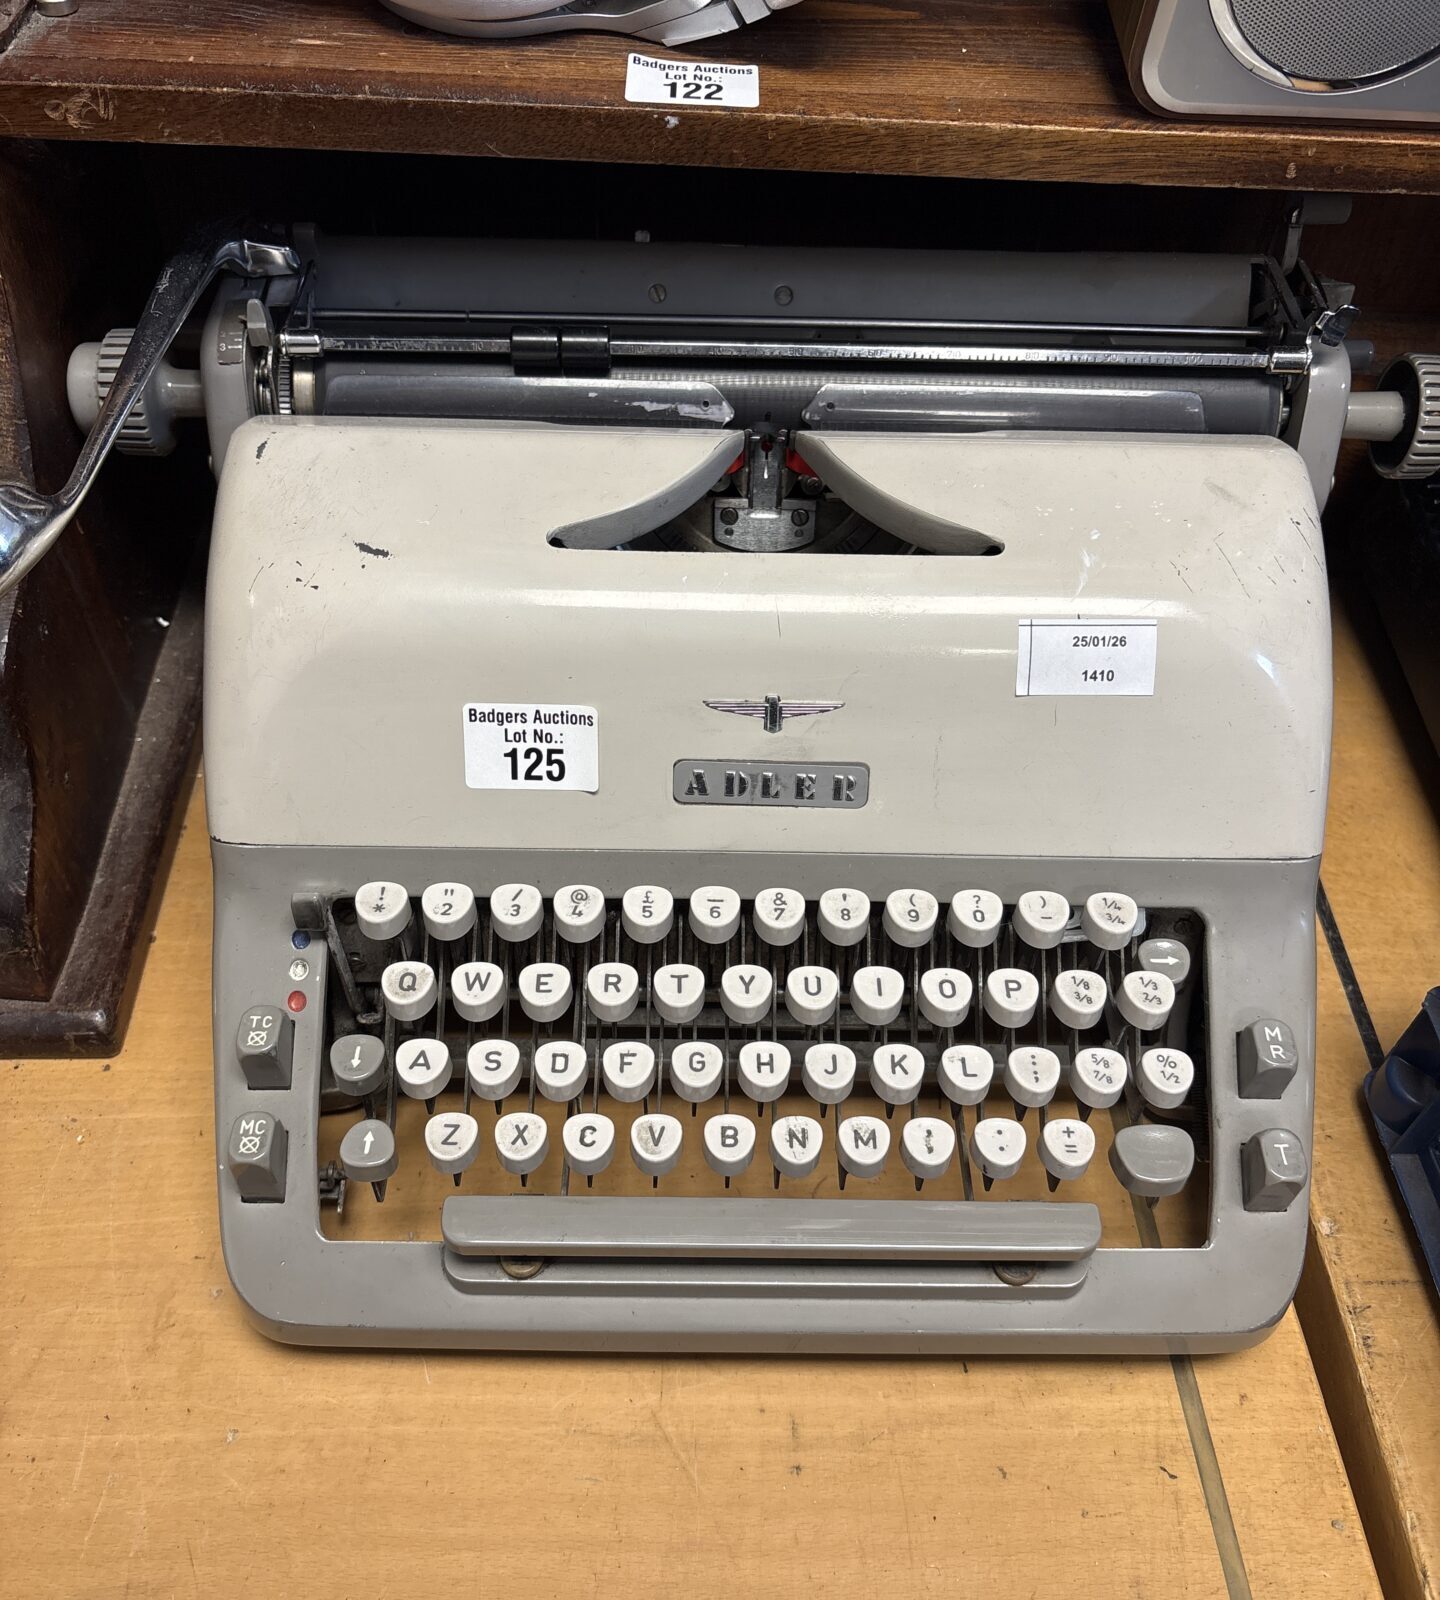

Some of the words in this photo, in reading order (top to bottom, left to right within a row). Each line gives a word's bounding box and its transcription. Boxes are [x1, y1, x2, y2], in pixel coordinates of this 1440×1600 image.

[632, 55, 689, 72] Badgers
[693, 64, 754, 76] Auctions
[665, 72, 687, 81] Lot
[663, 82, 724, 101] 122
[219, 342, 227, 352] 3
[1072, 635, 1127, 648] 25/01/26
[1081, 669, 1115, 682] 1410
[468, 708, 528, 726] Badgers
[533, 709, 594, 727] Auctions
[504, 728, 527, 744] Lot
[533, 729, 564, 744] No.:
[503, 747, 566, 782] 125
[684, 768, 858, 802] ADLER
[570, 888, 589, 905] @
[641, 890, 654, 904] £
[773, 891, 788, 906] &
[972, 894, 982, 909] ?
[440, 902, 454, 916] 2
[510, 903, 522, 917] 3
[572, 904, 584, 917] 4
[642, 905, 653, 919] 5
[709, 905, 721, 919] 6
[774, 907, 786, 921] 7
[840, 908, 851, 921] 8
[907, 908, 920, 922] 9
[399, 972, 416, 991] Q
[465, 972, 491, 991] W
[536, 974, 553, 992] E
[604, 974, 621, 992] R
[671, 975, 688, 993] T
[739, 975, 755, 994] Y
[804, 976, 821, 996] U
[877, 978, 882, 996] I
[939, 980, 956, 998] O
[1005, 980, 1021, 998] P
[250, 1015, 273, 1028] TC
[1264, 1026, 1282, 1042] M
[1269, 1044, 1286, 1059] R
[409, 1050, 430, 1070] A
[485, 1051, 501, 1071] S
[551, 1053, 568, 1073] D
[620, 1053, 636, 1073] F
[689, 1052, 705, 1072] G
[757, 1054, 773, 1073] H
[824, 1055, 837, 1074] J
[891, 1055, 908, 1075] K
[961, 1057, 977, 1077] L
[239, 1119, 267, 1135] MC
[441, 1124, 460, 1145] Z
[511, 1125, 528, 1145] X
[579, 1126, 596, 1147] C
[648, 1126, 665, 1146] V
[721, 1126, 738, 1147] B
[788, 1128, 808, 1148] N
[854, 1129, 876, 1149] M
[1273, 1143, 1289, 1166] T
